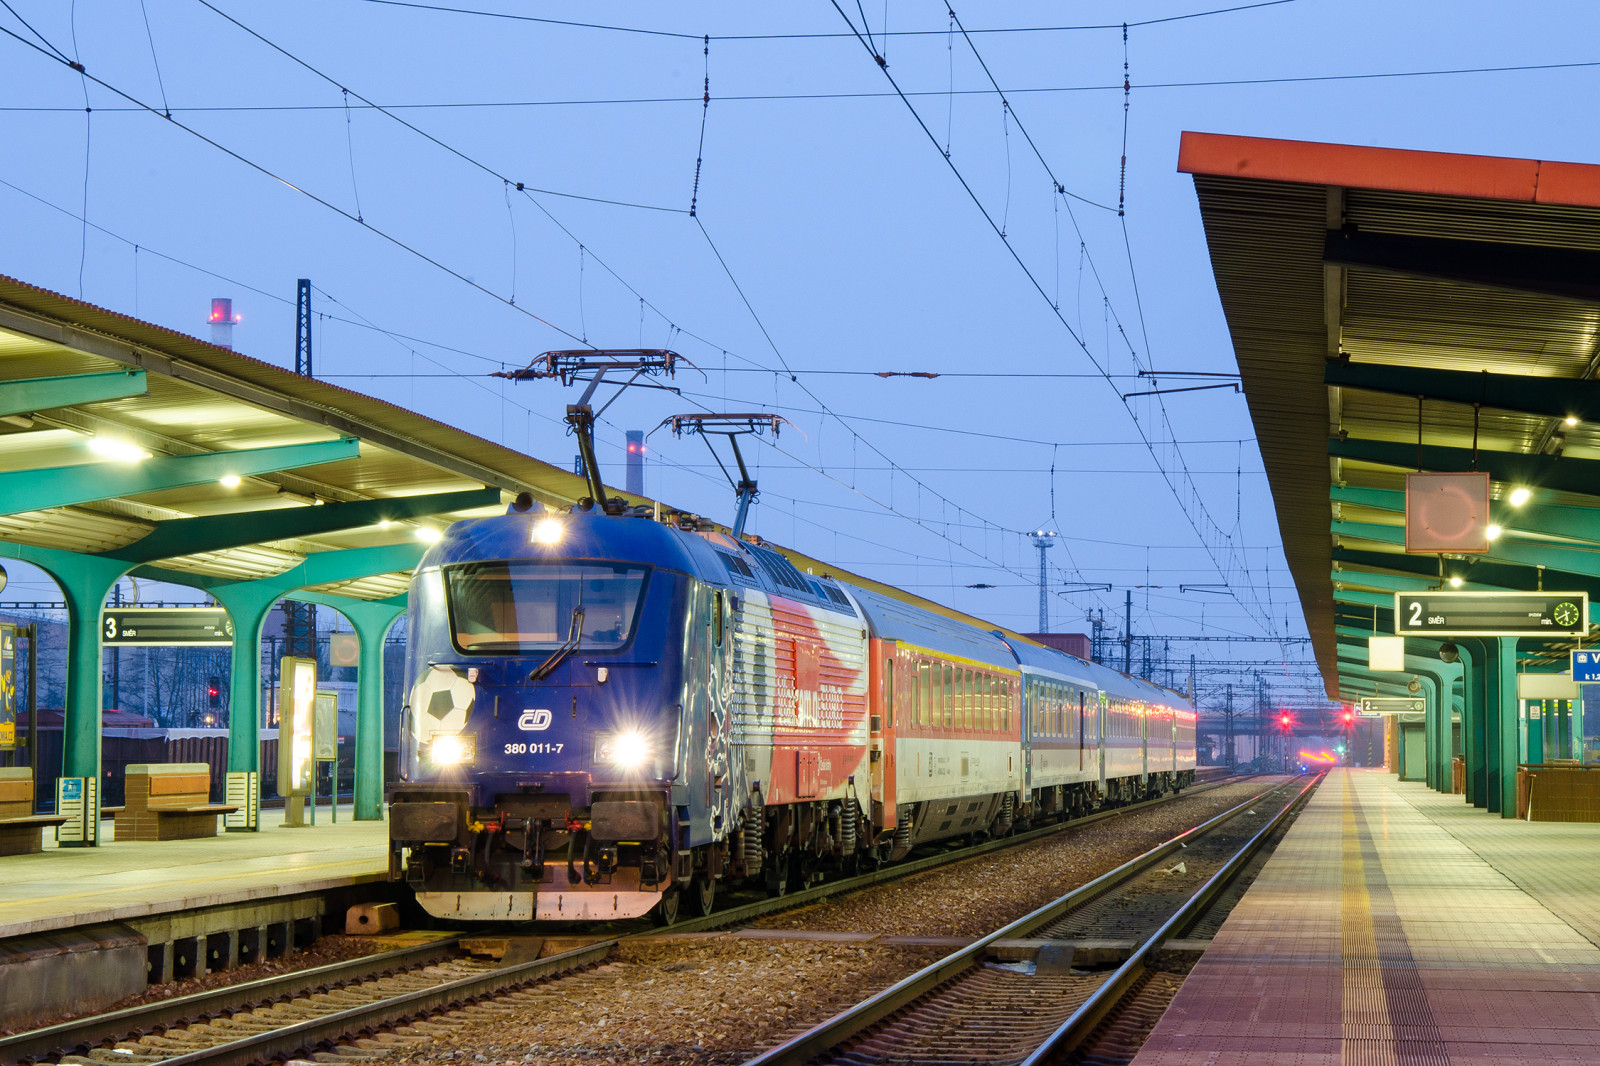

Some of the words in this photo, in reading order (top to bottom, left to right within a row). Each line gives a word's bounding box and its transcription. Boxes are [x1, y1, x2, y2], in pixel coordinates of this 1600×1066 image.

[1408, 602, 1422, 626] 2
[1427, 615, 1445, 625] SMĚR
[105, 617, 117, 638] 3
[122, 629, 136, 637] SMĚR
[1365, 701, 1371, 710] 2
[504, 743, 527, 754] 380
[529, 743, 564, 754] 011-7
